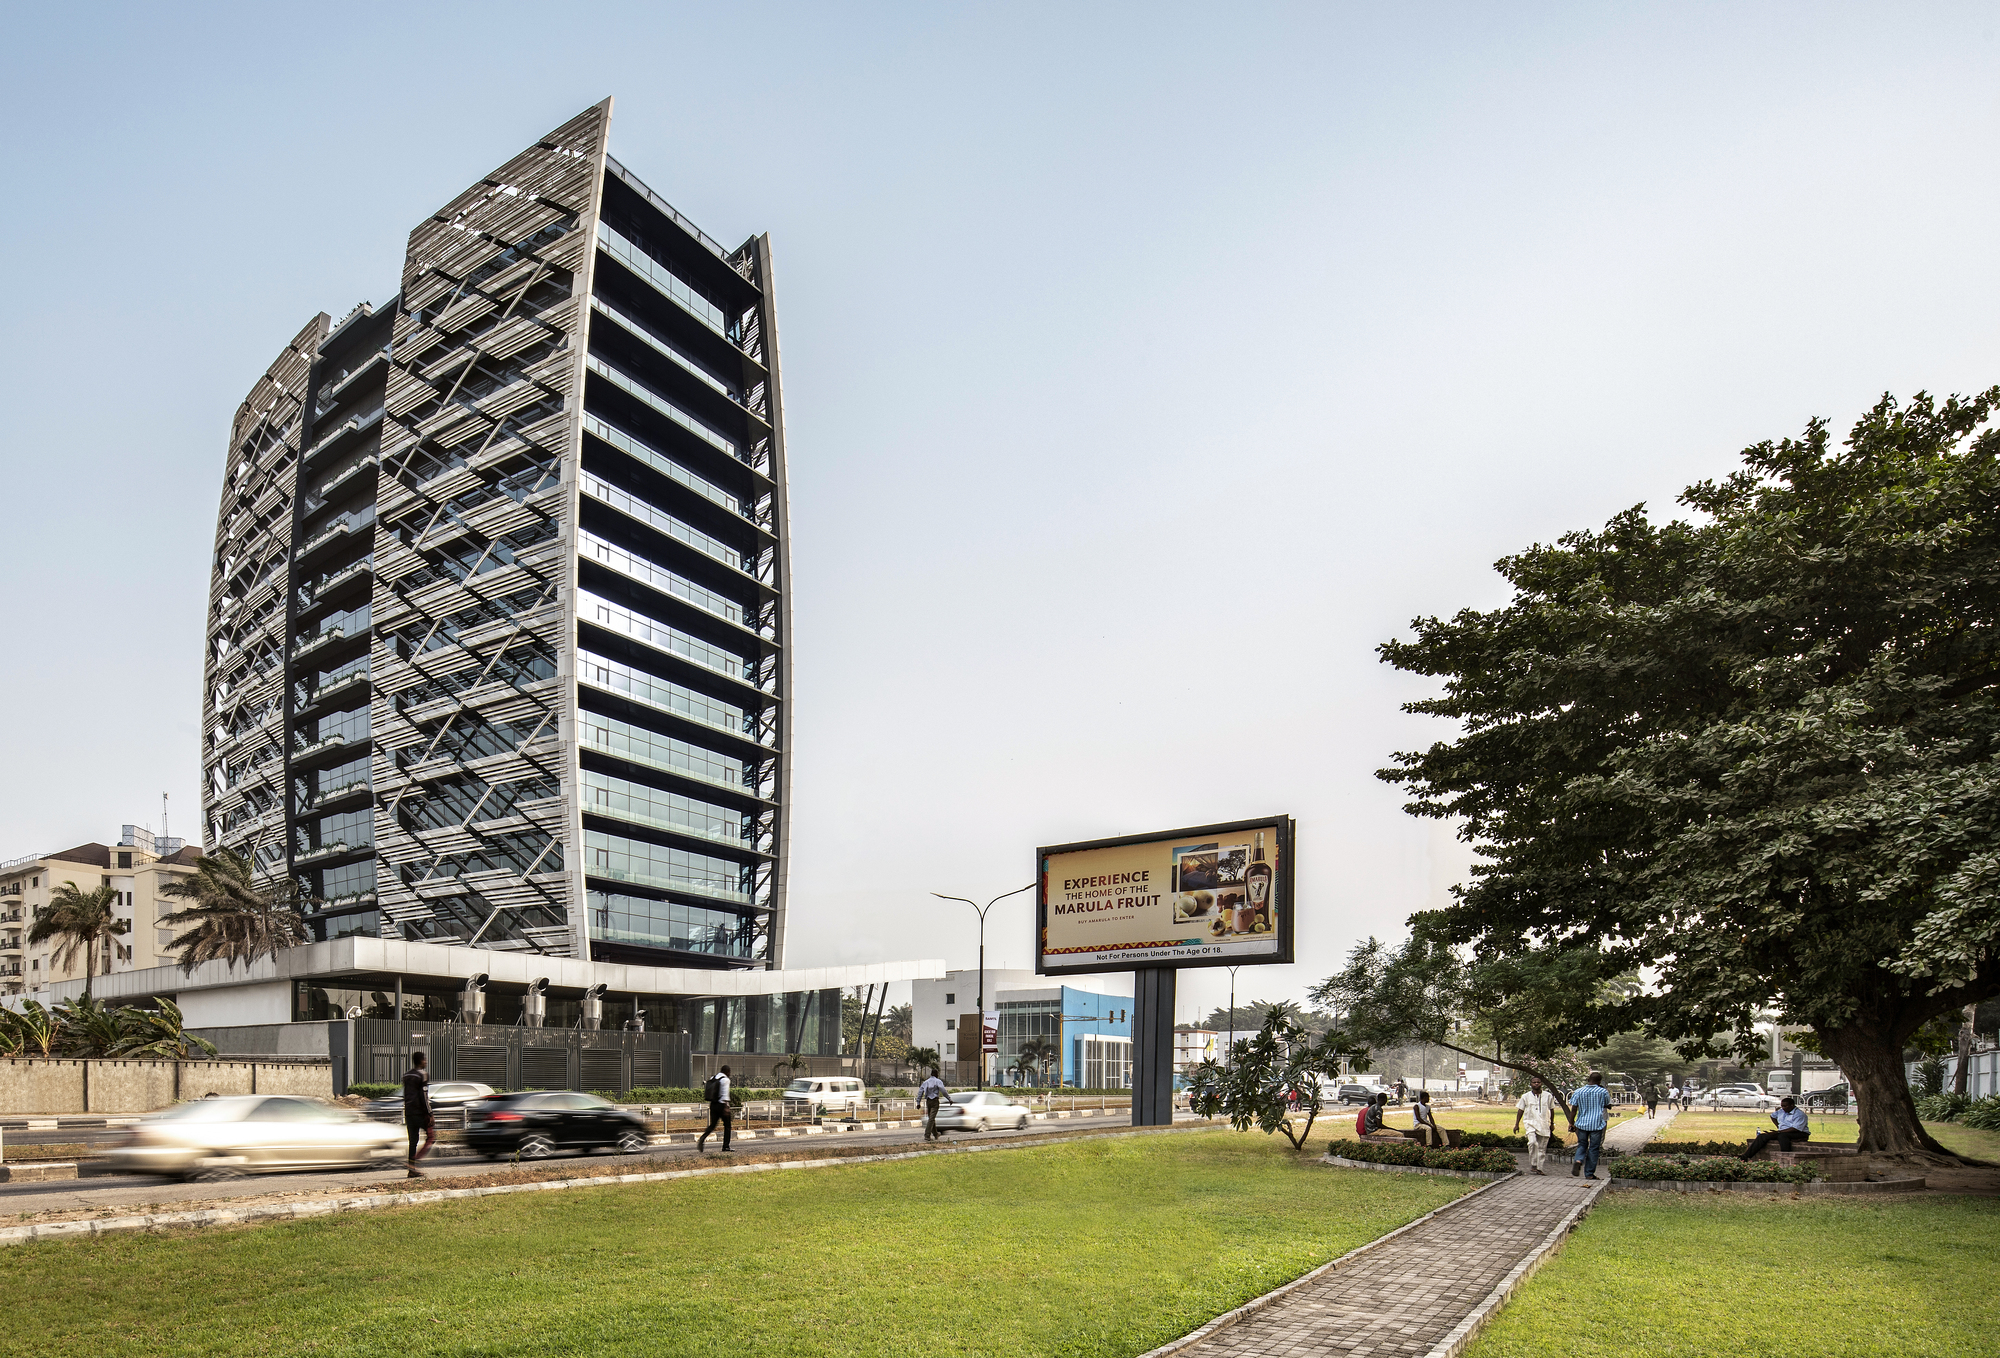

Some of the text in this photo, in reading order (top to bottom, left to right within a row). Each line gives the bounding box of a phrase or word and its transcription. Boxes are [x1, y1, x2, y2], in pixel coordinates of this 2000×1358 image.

[1064, 870, 1149, 890] EXPERIENCE
[1065, 885, 1149, 900] THE HOME OF THE
[1054, 894, 1161, 915] MARULA FRUIT
[1121, 951, 1149, 959] Persons
[1186, 948, 1200, 956] Age
[1212, 946, 1223, 954] 18.
